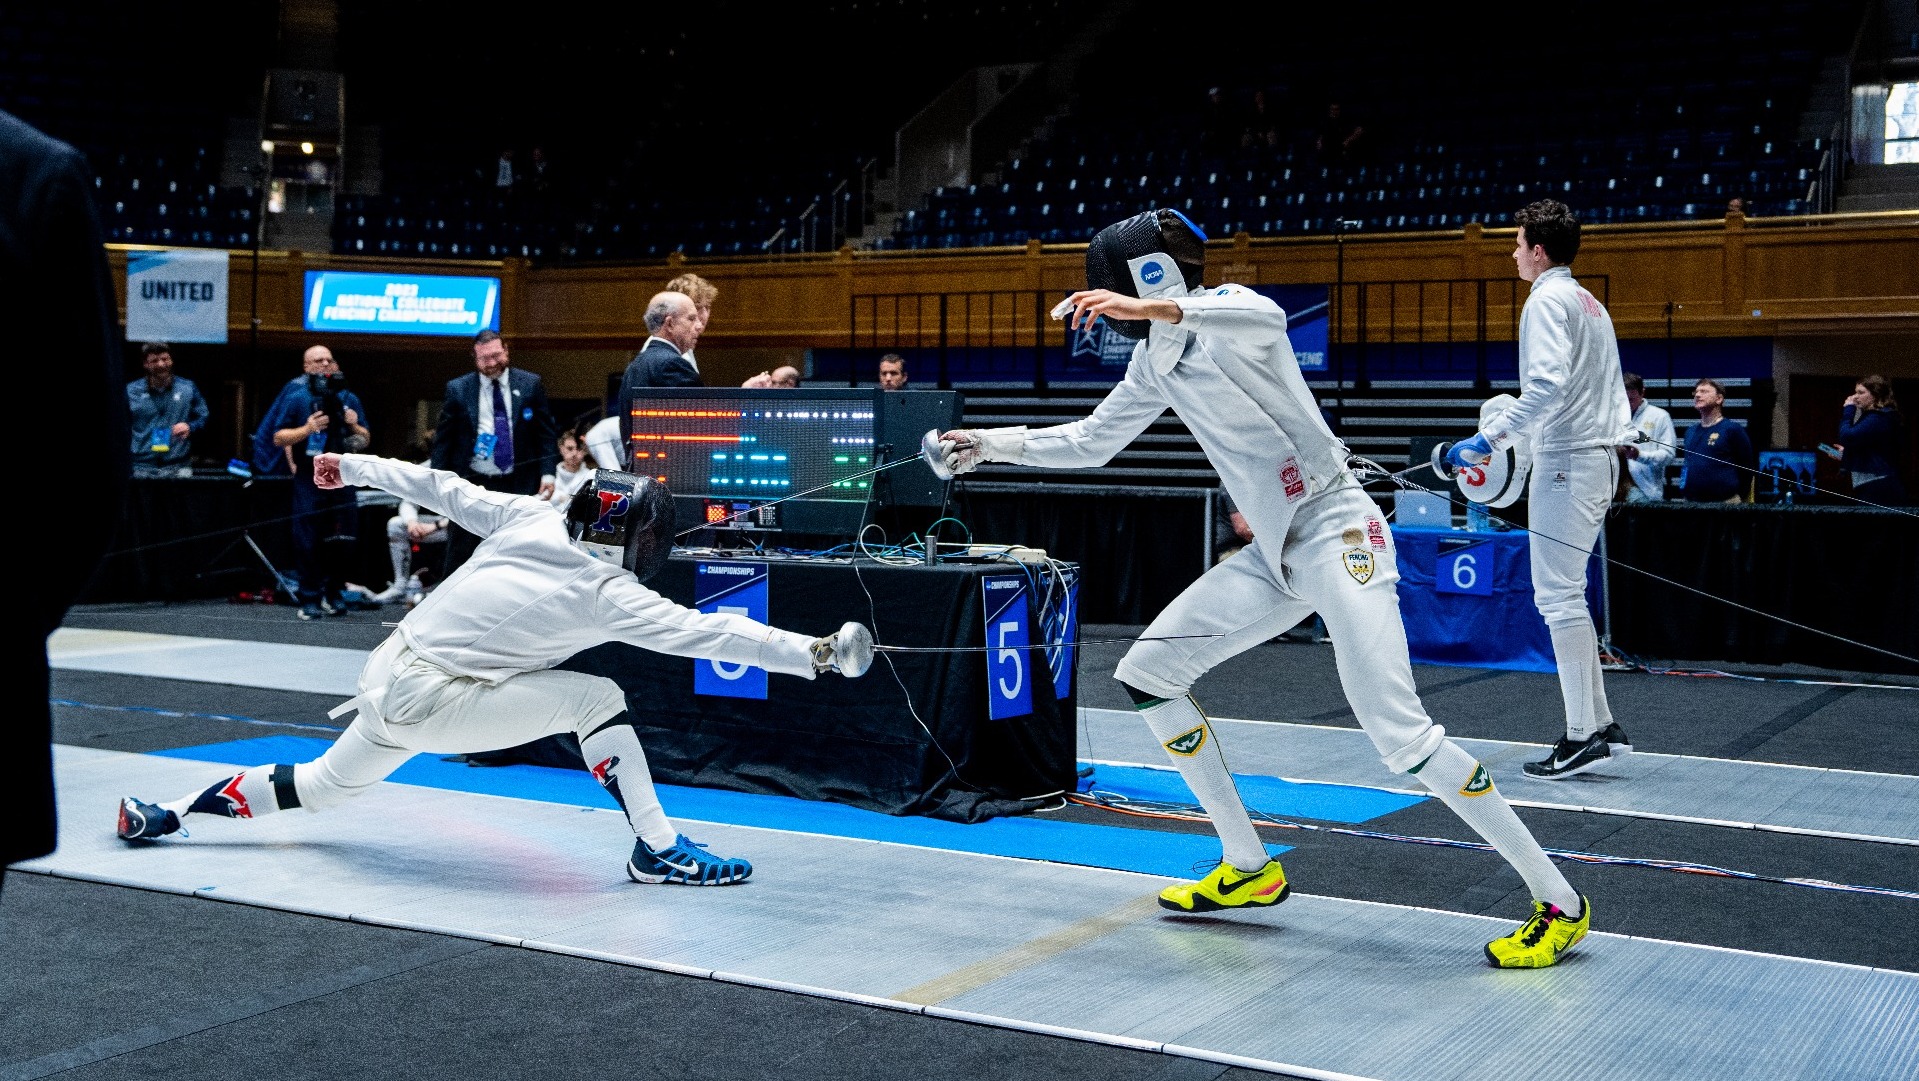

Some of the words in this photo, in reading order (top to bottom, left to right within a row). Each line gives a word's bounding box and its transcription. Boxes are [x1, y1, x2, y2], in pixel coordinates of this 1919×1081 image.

[141, 281, 215, 301] UNITED
[592, 490, 630, 533] P
[707, 565, 755, 576] CHAMPIONSHIPS
[1453, 553, 1476, 589] 6
[999, 621, 1023, 700] 5
